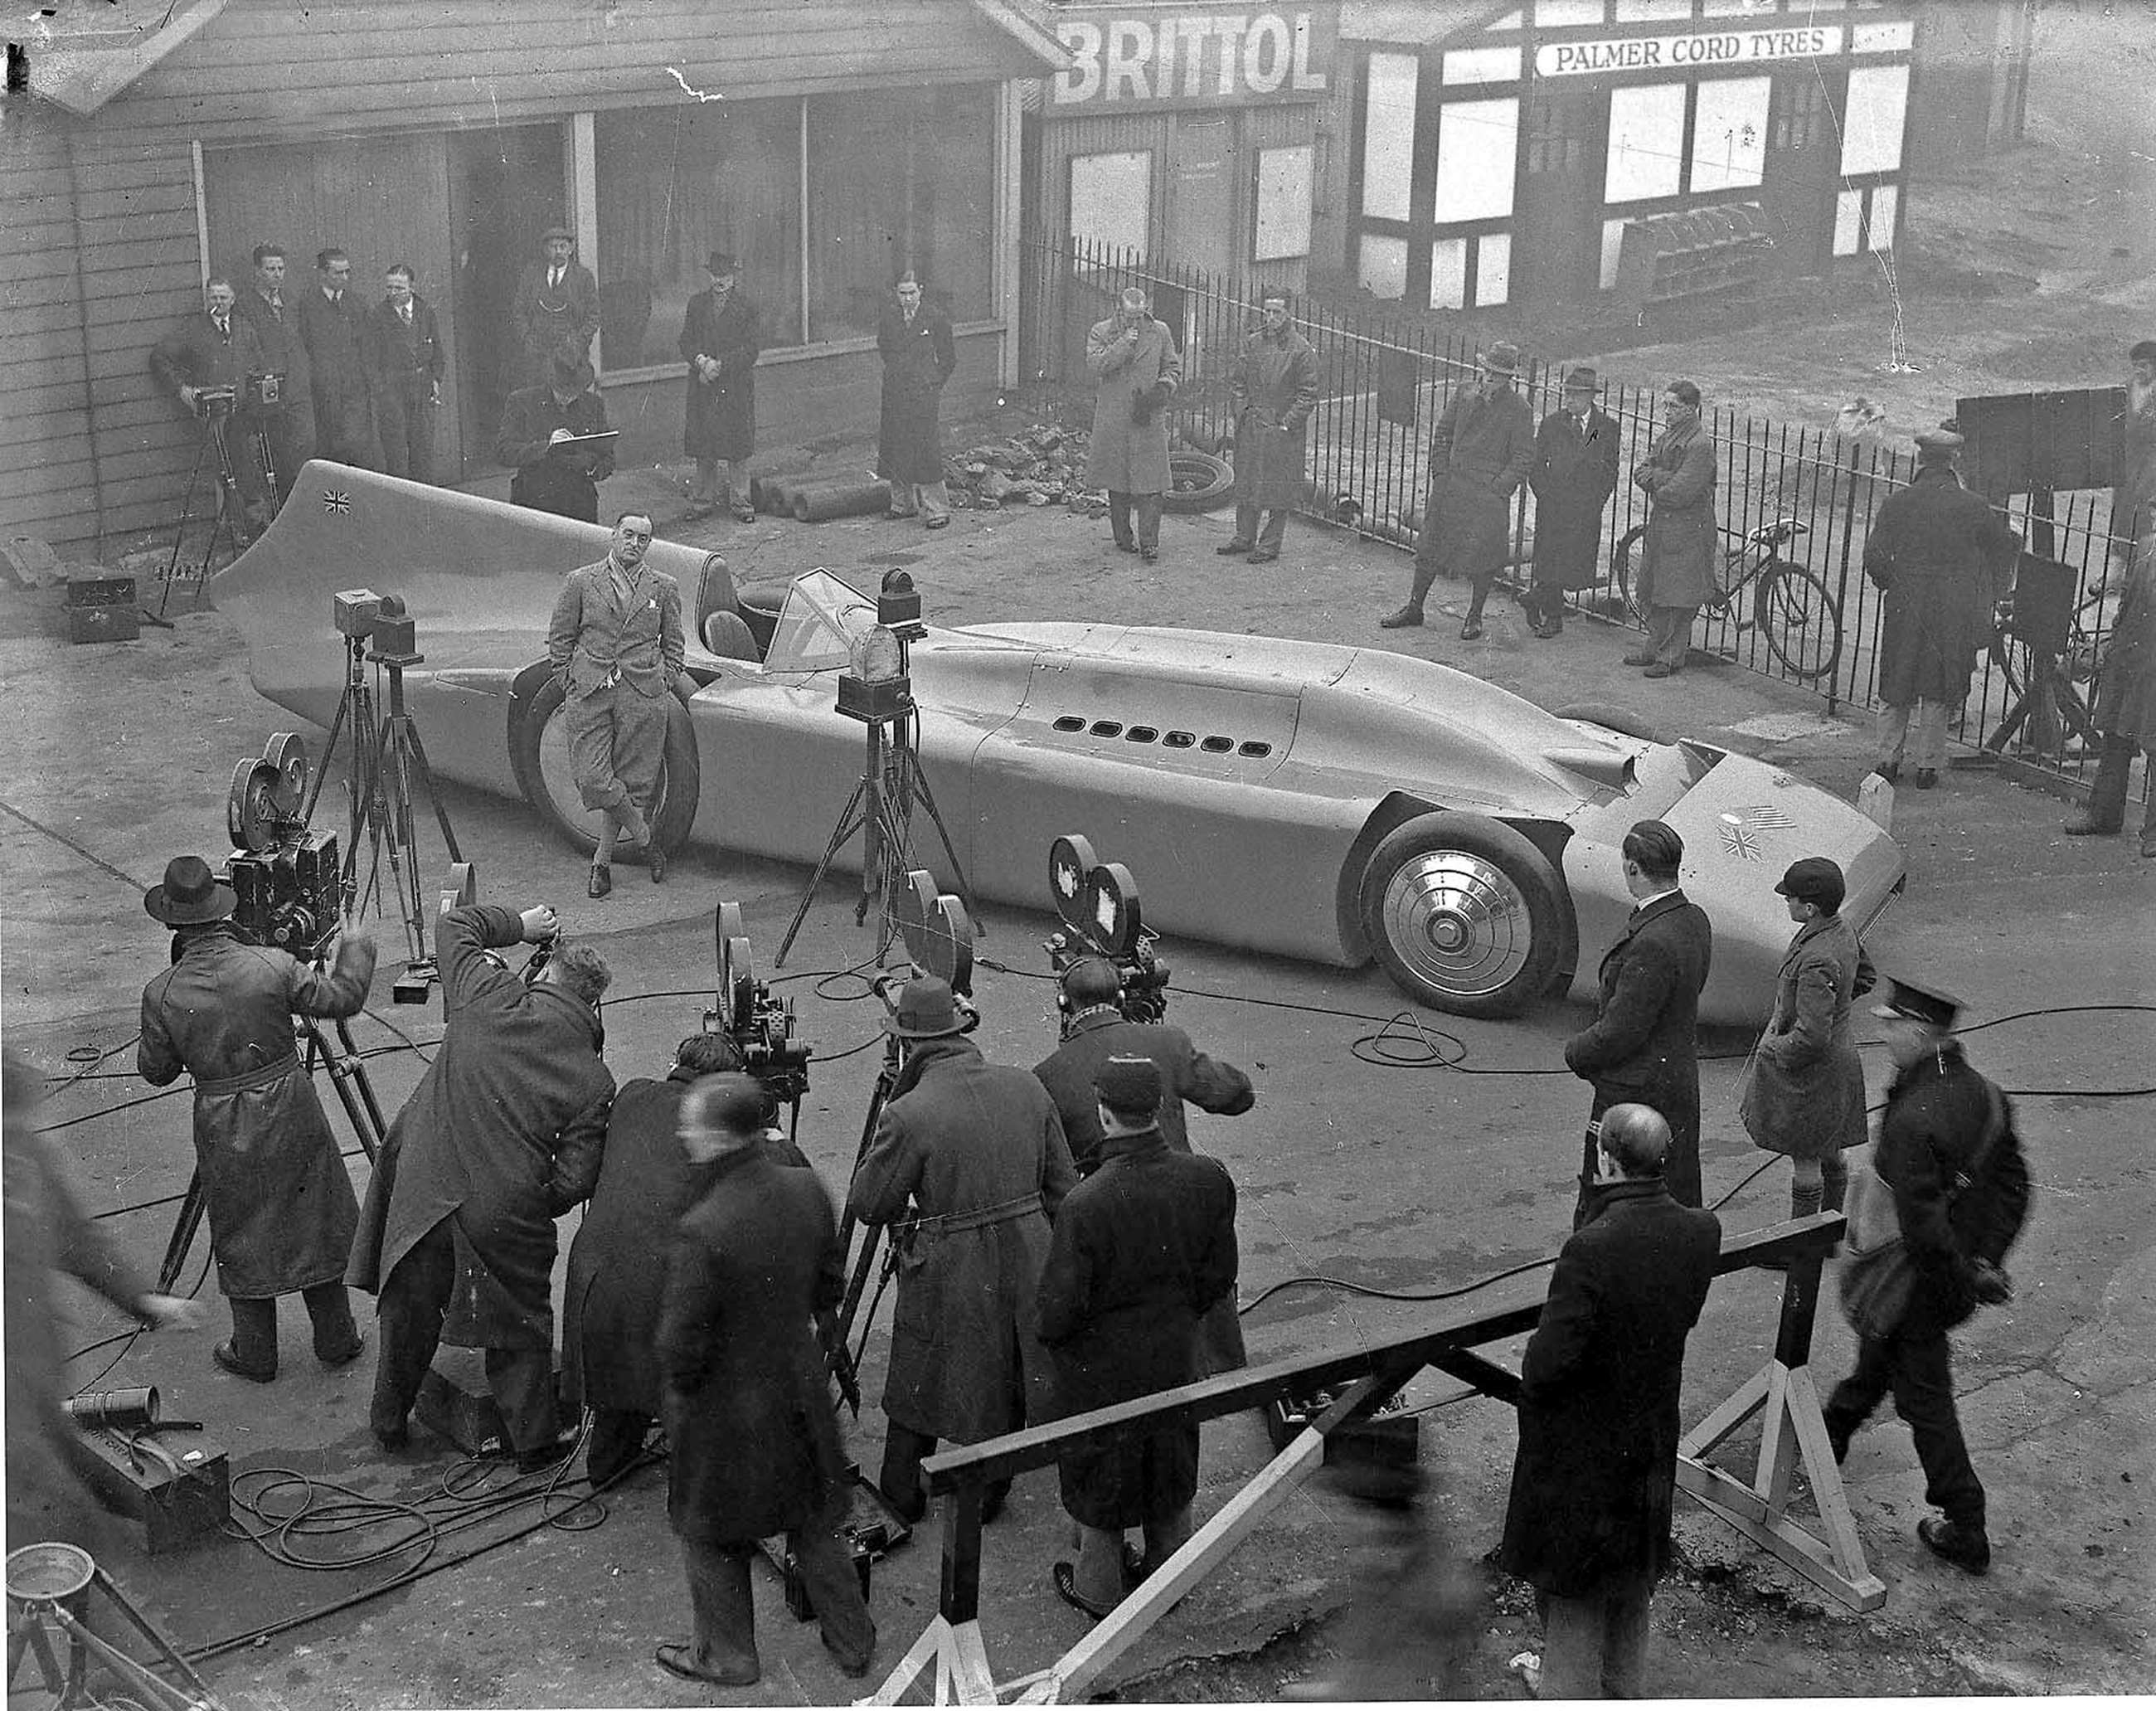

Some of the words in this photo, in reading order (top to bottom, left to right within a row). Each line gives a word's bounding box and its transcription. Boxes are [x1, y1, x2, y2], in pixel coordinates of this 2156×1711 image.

[1054, 13, 1327, 105] BRITTOL
[1556, 41, 1661, 72] PALMER
[1672, 36, 1741, 62] CORD
[1750, 29, 1824, 57] TYRES
